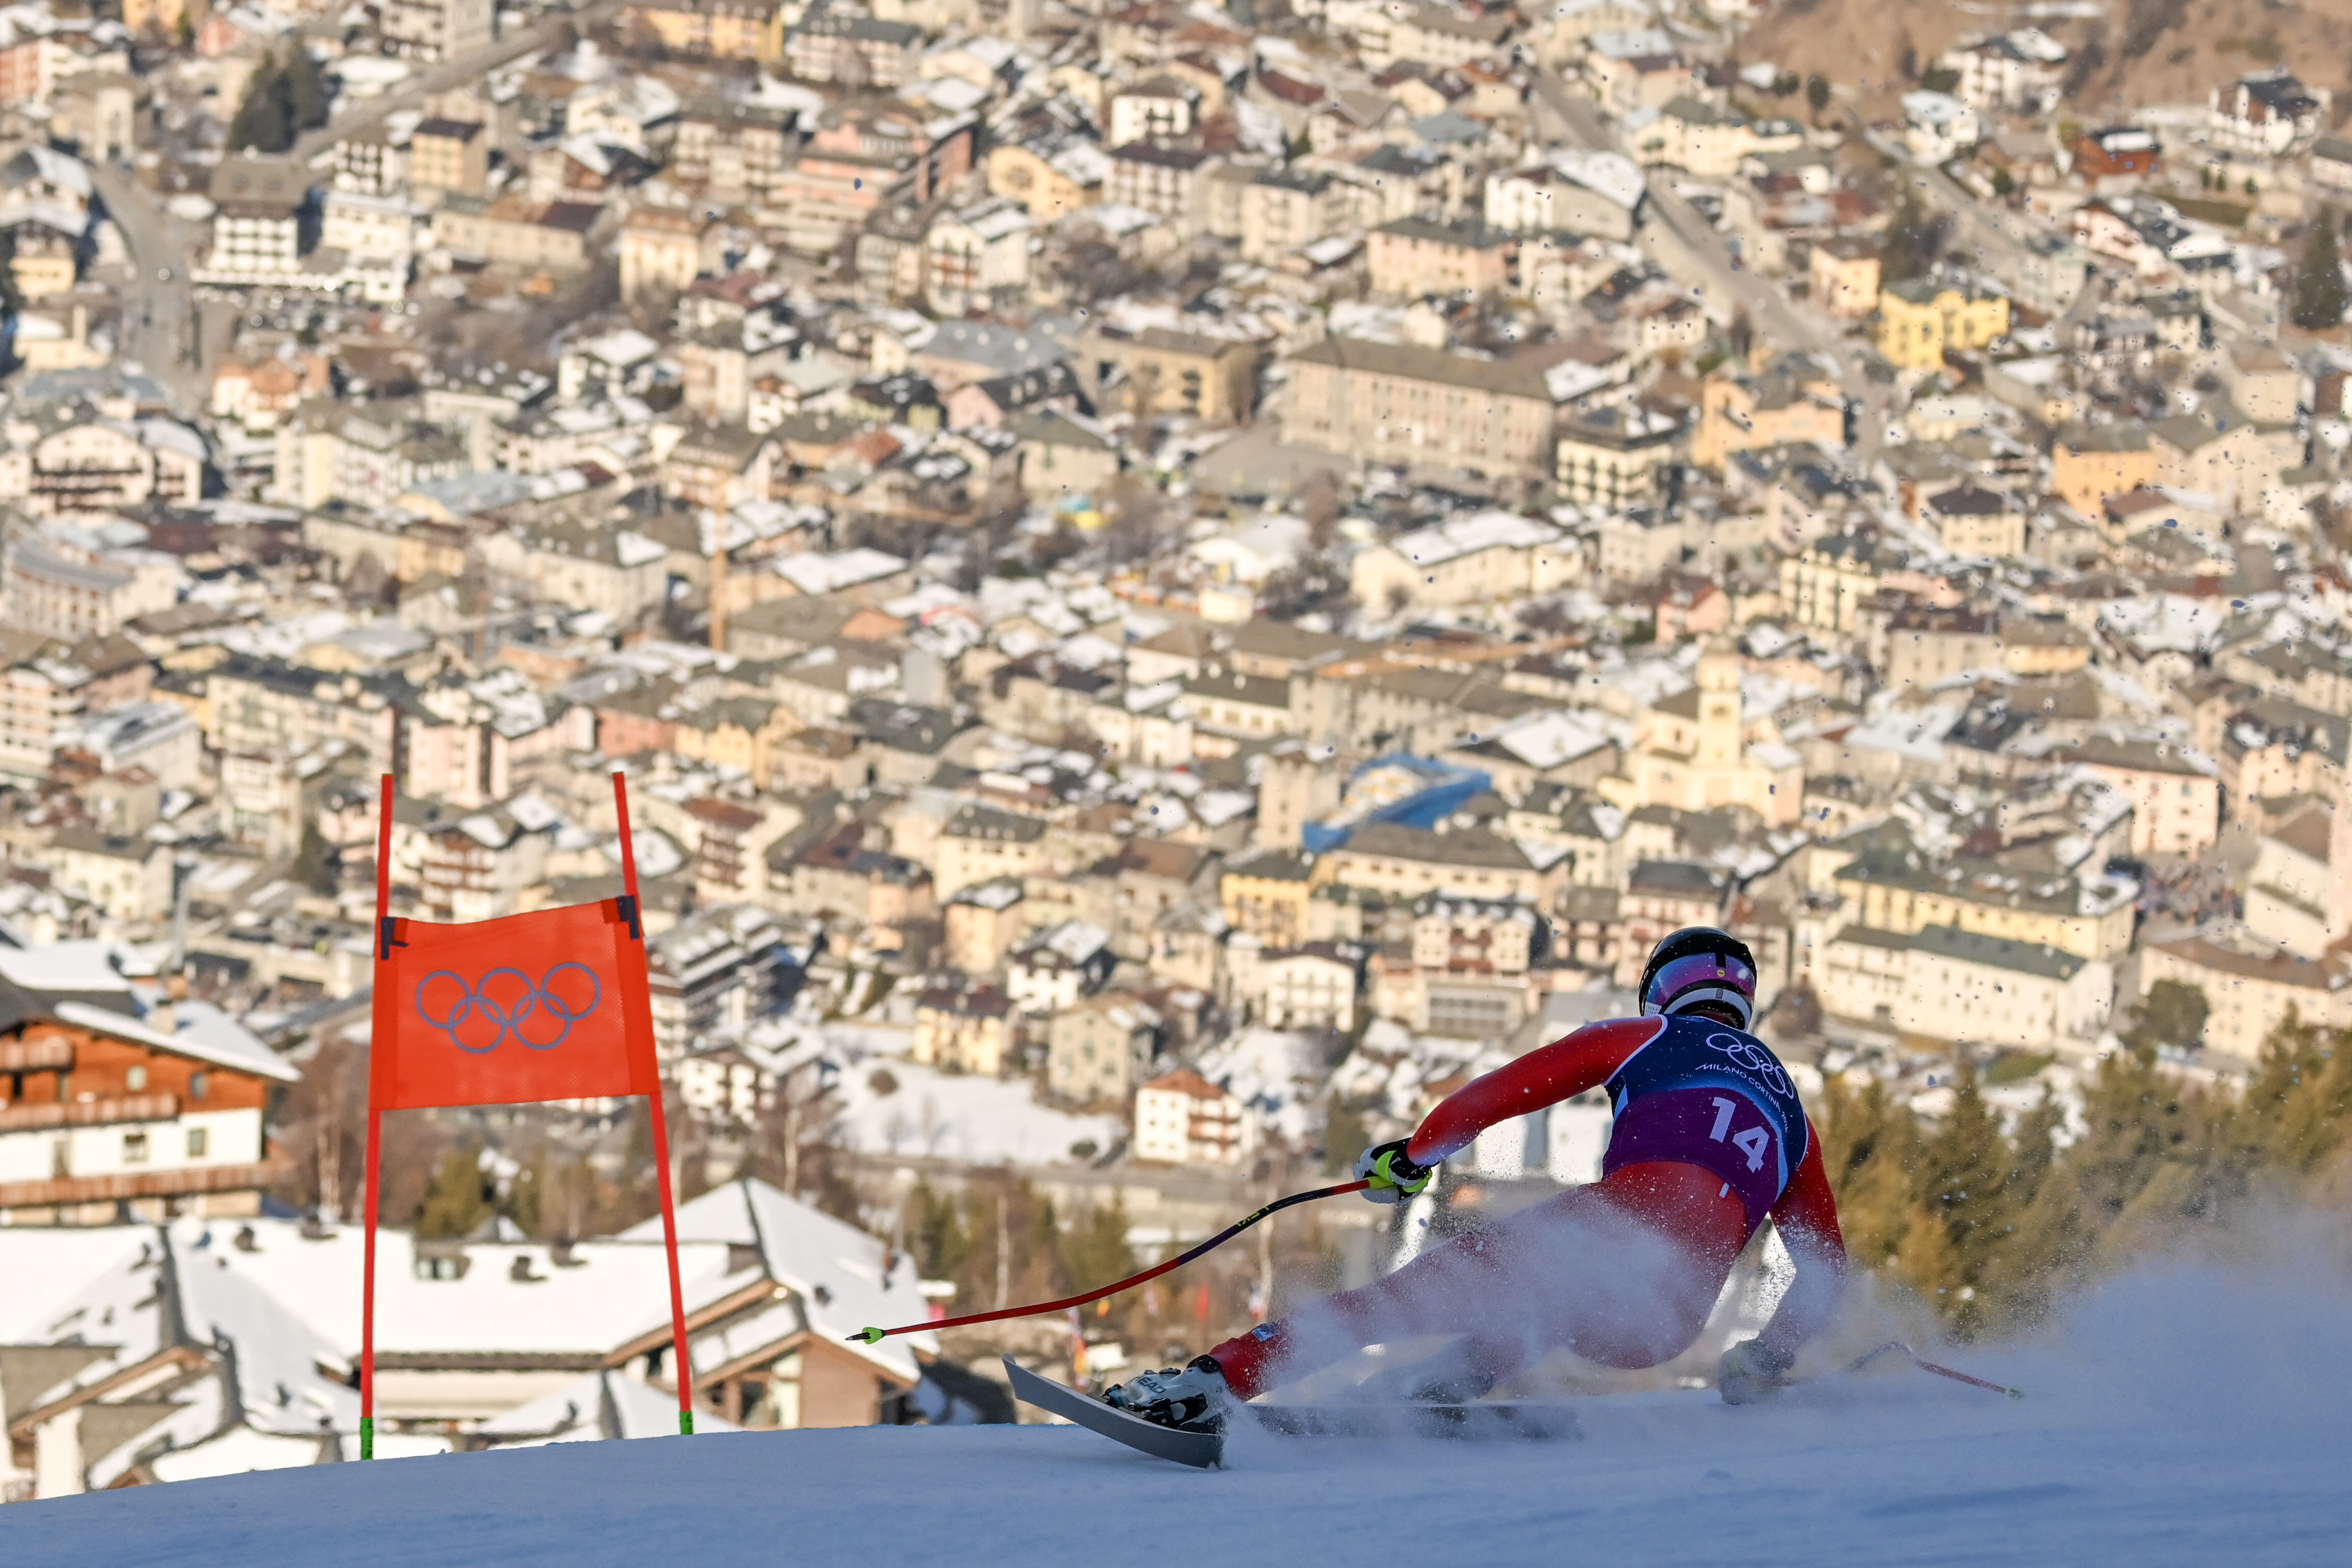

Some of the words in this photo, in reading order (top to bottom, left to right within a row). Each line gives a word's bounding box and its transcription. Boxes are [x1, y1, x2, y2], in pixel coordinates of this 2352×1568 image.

[1695, 1064, 1747, 1079] MILANO
[1748, 1077, 1781, 1112] CORTINA
[1709, 1096, 1769, 1174] 14
[1237, 1207, 1269, 1227] EKI
[1135, 1376, 1167, 1394] EAD
